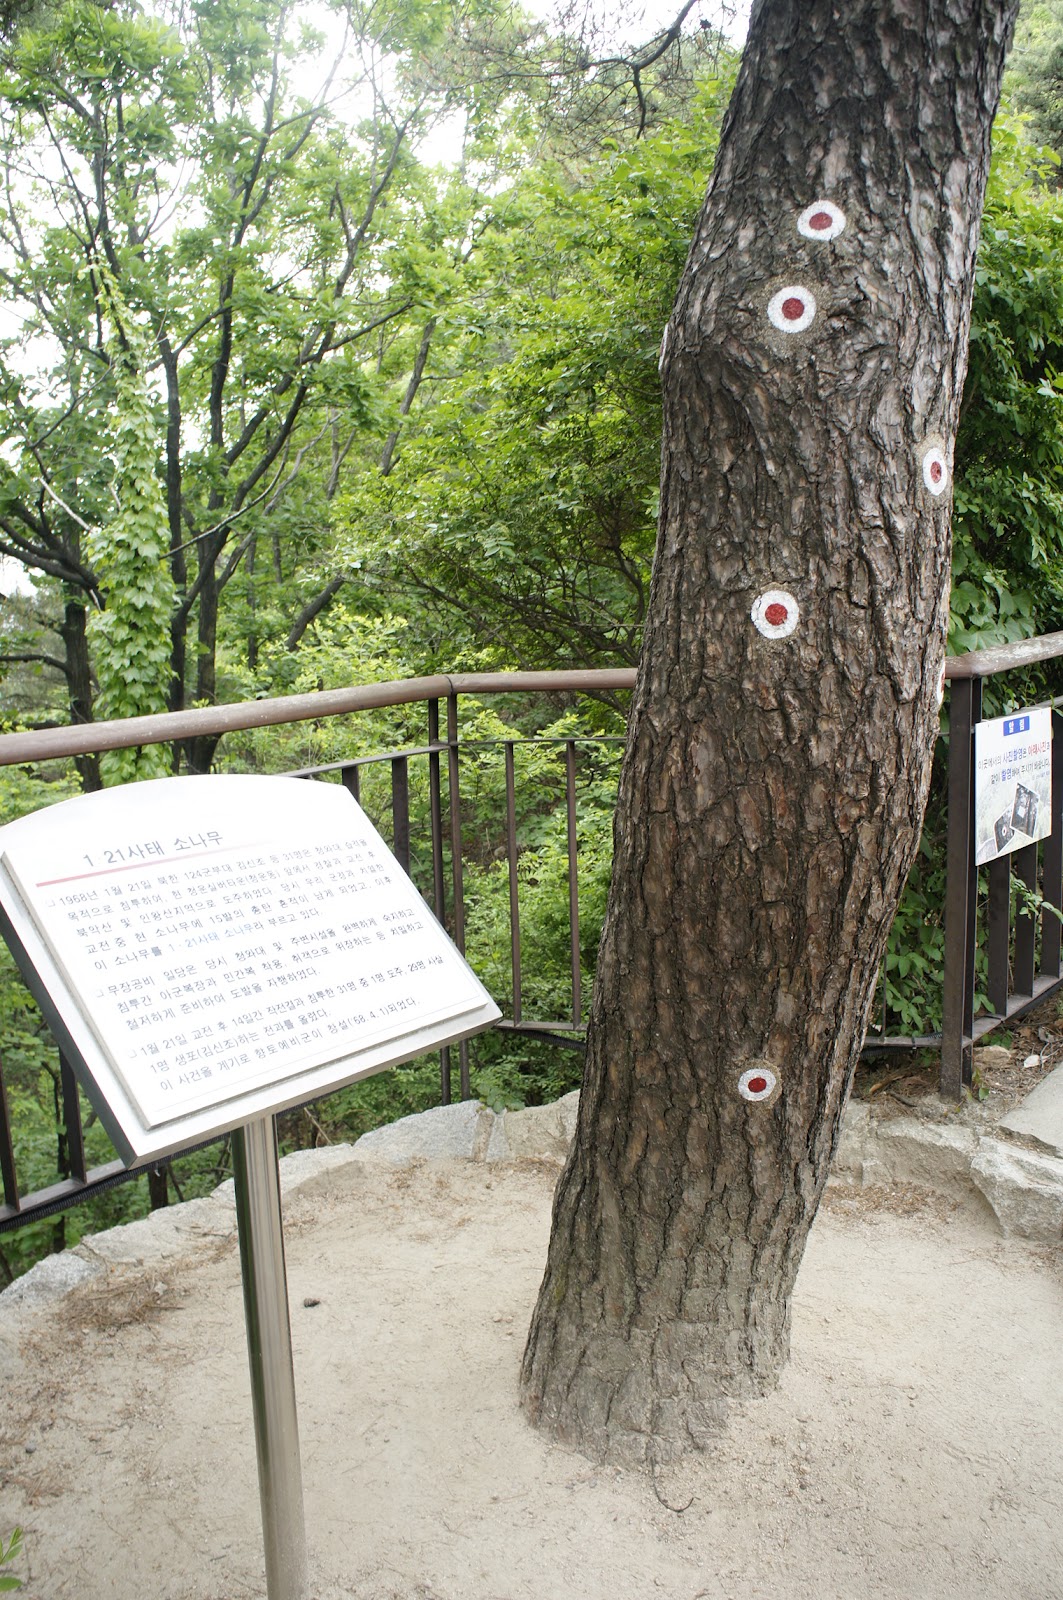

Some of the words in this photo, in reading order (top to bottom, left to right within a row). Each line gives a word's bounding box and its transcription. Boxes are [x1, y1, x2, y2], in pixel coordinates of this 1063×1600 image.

[59, 890, 99, 906] 1968년
[104, 885, 123, 897] 1월
[127, 879, 153, 892] 21일
[157, 874, 178, 886] 북한
[184, 863, 233, 880] 124군부대
[236, 857, 266, 871] 김신조
[269, 855, 280, 864] 등
[282, 849, 311, 861] 31명은
[314, 843, 342, 855] 청와대
[173, 830, 223, 851] 소나무
[67, 904, 114, 922] 목적으로
[314, 857, 342, 870] 경찰과
[346, 853, 363, 863] 교전
[367, 850, 376, 858] 후
[75, 921, 113, 937] 북악산
[119, 917, 132, 929] 및
[139, 899, 217, 924] 인왕산지역으로
[280, 880, 301, 892] 당시
[304, 876, 324, 887] 우리
[328, 869, 355, 882] 군경과
[359, 863, 385, 875] 치열한
[85, 939, 111, 955] 교전
[113, 936, 127, 948] 중
[155, 918, 204, 938] 소나무에
[209, 908, 245, 925] 15발의
[250, 902, 273, 915] 총탄
[278, 894, 310, 909] 흔적이
[313, 888, 335, 901] 남게
[374, 876, 392, 886] 이후
[94, 959, 108, 970] 이
[114, 945, 163, 966] 소나무를
[224, 920, 265, 938] 소나무라
[267, 913, 298, 927] 부르고
[107, 975, 156, 996] 무장공비
[163, 964, 198, 982] 일당은
[204, 955, 228, 970] 당시
[234, 945, 267, 962] 청와대
[272, 941, 284, 952] 및
[289, 928, 337, 947] 주변시설을
[341, 917, 378, 934] 완벽하게
[382, 908, 415, 923] 숙지하고
[116, 994, 153, 1014] 침투간
[159, 976, 217, 1000] 아군복장과
[223, 966, 257, 983] 민간복
[261, 959, 288, 971] 착용,
[291, 946, 331, 964] 취객으로
[335, 936, 373, 952] 위장하는
[375, 930, 386, 941] 등
[390, 921, 424, 936] 치밀하고
[125, 1007, 176, 1031] 철저하게
[179, 992, 226, 1015] 준비하여
[230, 982, 263, 999] 도발을
[266, 966, 321, 988] 자행하였다.
[140, 1042, 160, 1056] 1월
[162, 1033, 188, 1050] 21일
[191, 1025, 214, 1041] 교전
[216, 1021, 228, 1032] 후
[231, 1009, 264, 1027] 14일간
[265, 997, 306, 1016] 작전결과
[307, 987, 336, 1005] 침투한
[336, 980, 358, 994] 31명
[358, 977, 370, 988] 중
[370, 972, 386, 984] 1명
[386, 966, 407, 979] 도주,
[407, 960, 427, 973] 29명
[427, 954, 444, 966] 사살
[150, 1059, 170, 1073] 1명
[175, 1031, 260, 1066] 생포(김신조)하는
[263, 1018, 295, 1037] 전과를
[297, 1008, 331, 1026] 올렸다.
[159, 1079, 174, 1091] 이
[178, 1066, 213, 1085] 사건을
[254, 1028, 323, 1059] 향토예비군이
